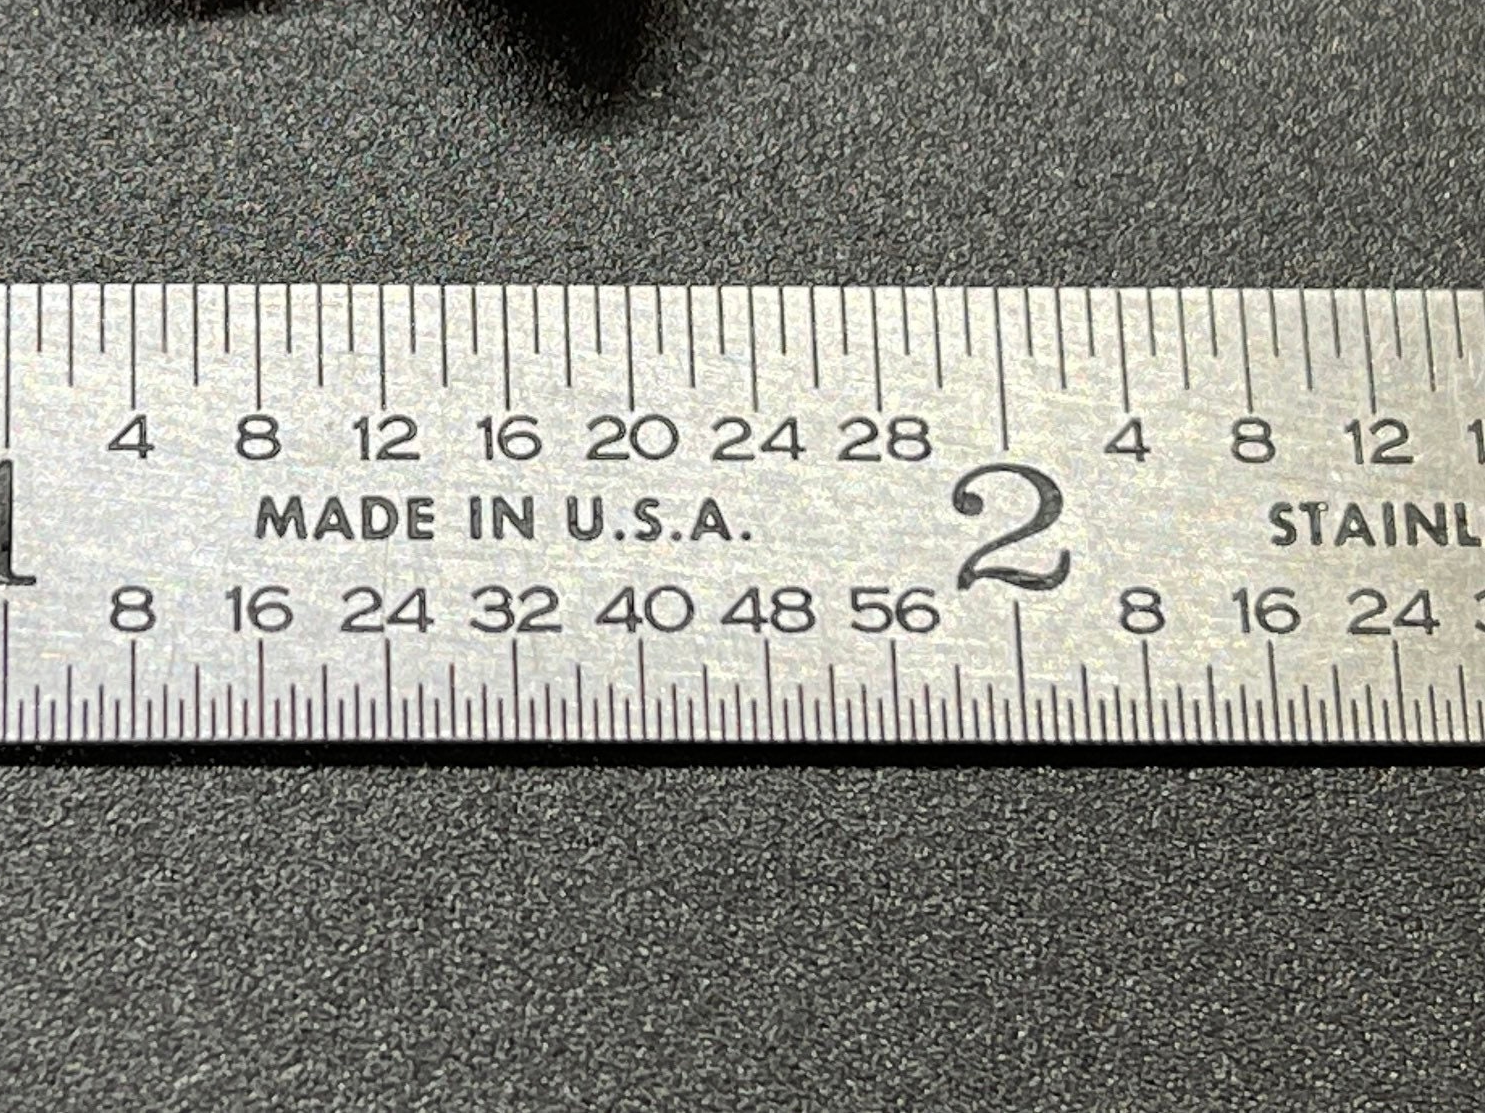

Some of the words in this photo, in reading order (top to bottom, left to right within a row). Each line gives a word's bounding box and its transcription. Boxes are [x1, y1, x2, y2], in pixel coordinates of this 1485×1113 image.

[107, 413, 155, 461] 4
[235, 413, 282, 462] 8
[352, 414, 421, 462] 12
[476, 414, 543, 462] 16
[586, 413, 680, 461] 20
[711, 415, 807, 462] 24
[837, 415, 932, 462] 28
[1103, 416, 1152, 463] 4
[1230, 416, 1277, 464] 8
[1343, 418, 1415, 465] 12
[256, 495, 436, 540] MADE
[469, 495, 535, 540] IN
[566, 495, 752, 542] U.S.A.
[951, 462, 1071, 592] 2
[1268, 501, 1482, 548] STAINL
[109, 585, 157, 634] 8
[225, 586, 294, 634] 16
[340, 586, 436, 634] 24
[469, 585, 563, 634] 32
[595, 585, 695, 634] 40
[720, 586, 817, 635] 48
[850, 586, 941, 635] 56
[1118, 586, 1166, 635] 8
[1232, 587, 1301, 635] 16
[1346, 588, 1441, 636] 24
